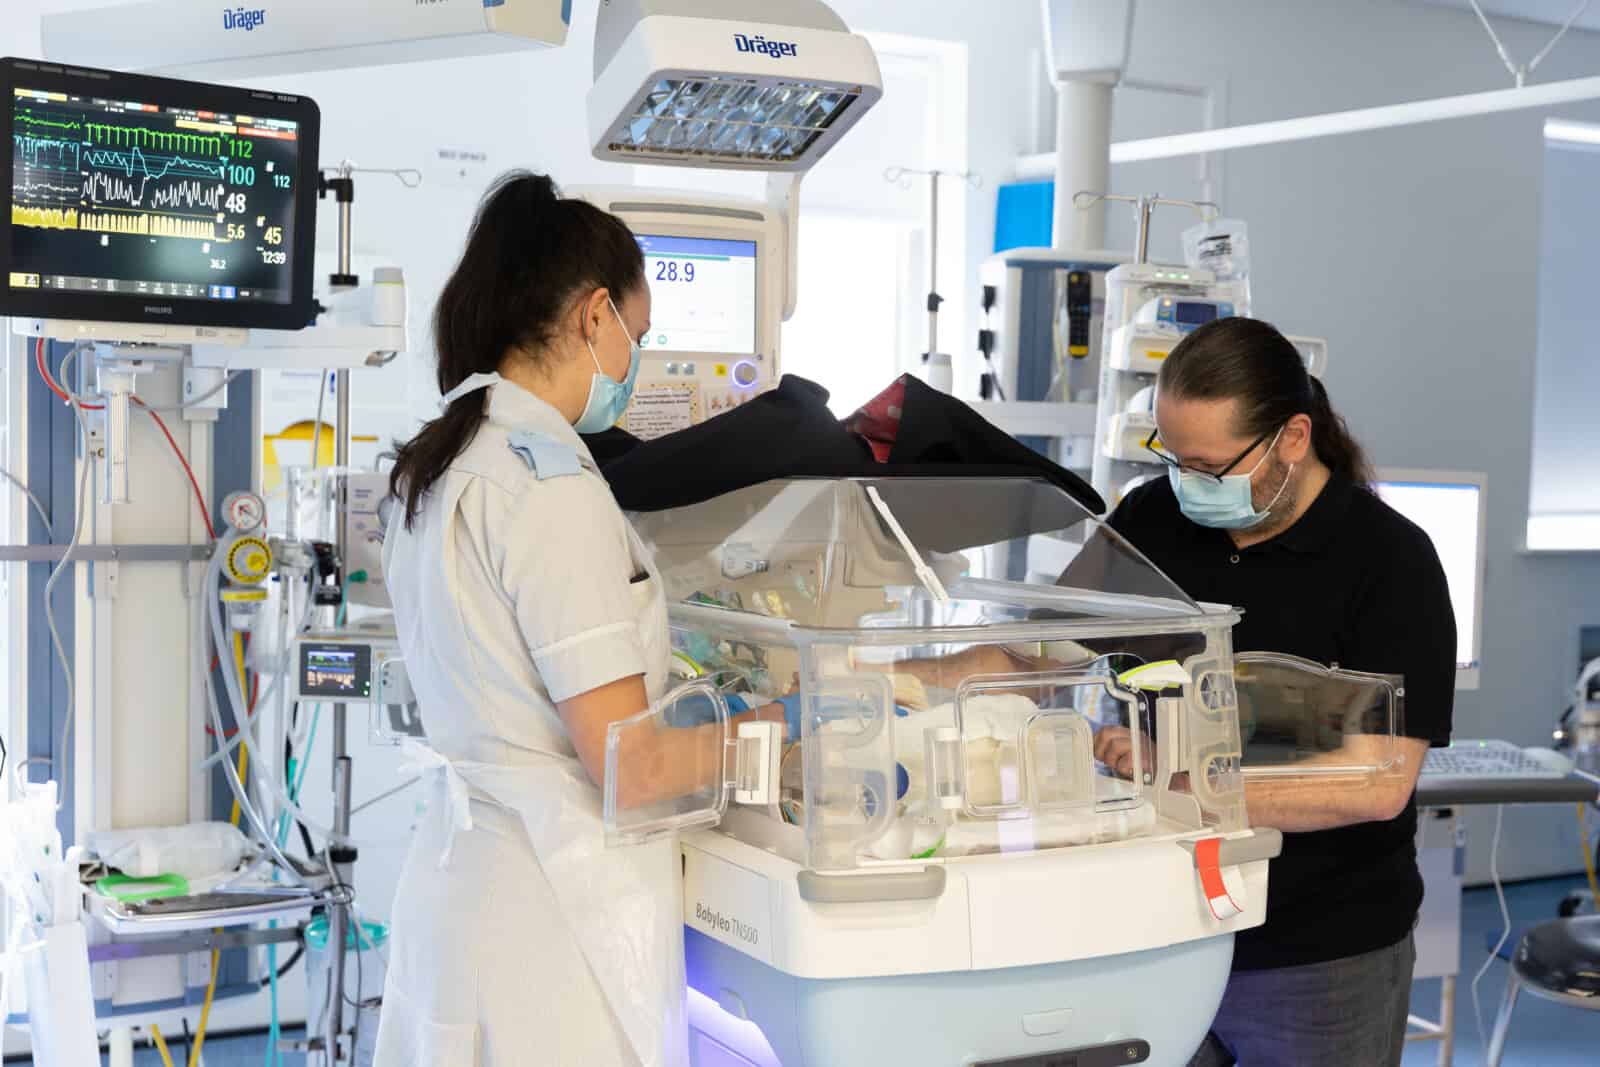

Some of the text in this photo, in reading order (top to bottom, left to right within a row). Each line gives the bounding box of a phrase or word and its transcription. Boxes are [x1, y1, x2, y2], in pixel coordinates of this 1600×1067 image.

[223, 8, 266, 31] Dräger
[733, 33, 798, 58] Dräger
[228, 139, 253, 159] 112
[228, 165, 255, 186] 100
[273, 174, 290, 188] 112
[225, 192, 247, 214] 48
[227, 223, 245, 240] 5.6
[263, 226, 282, 245] 45
[656, 261, 695, 282] 28.9
[695, 903, 759, 945] Babyleo TN500
